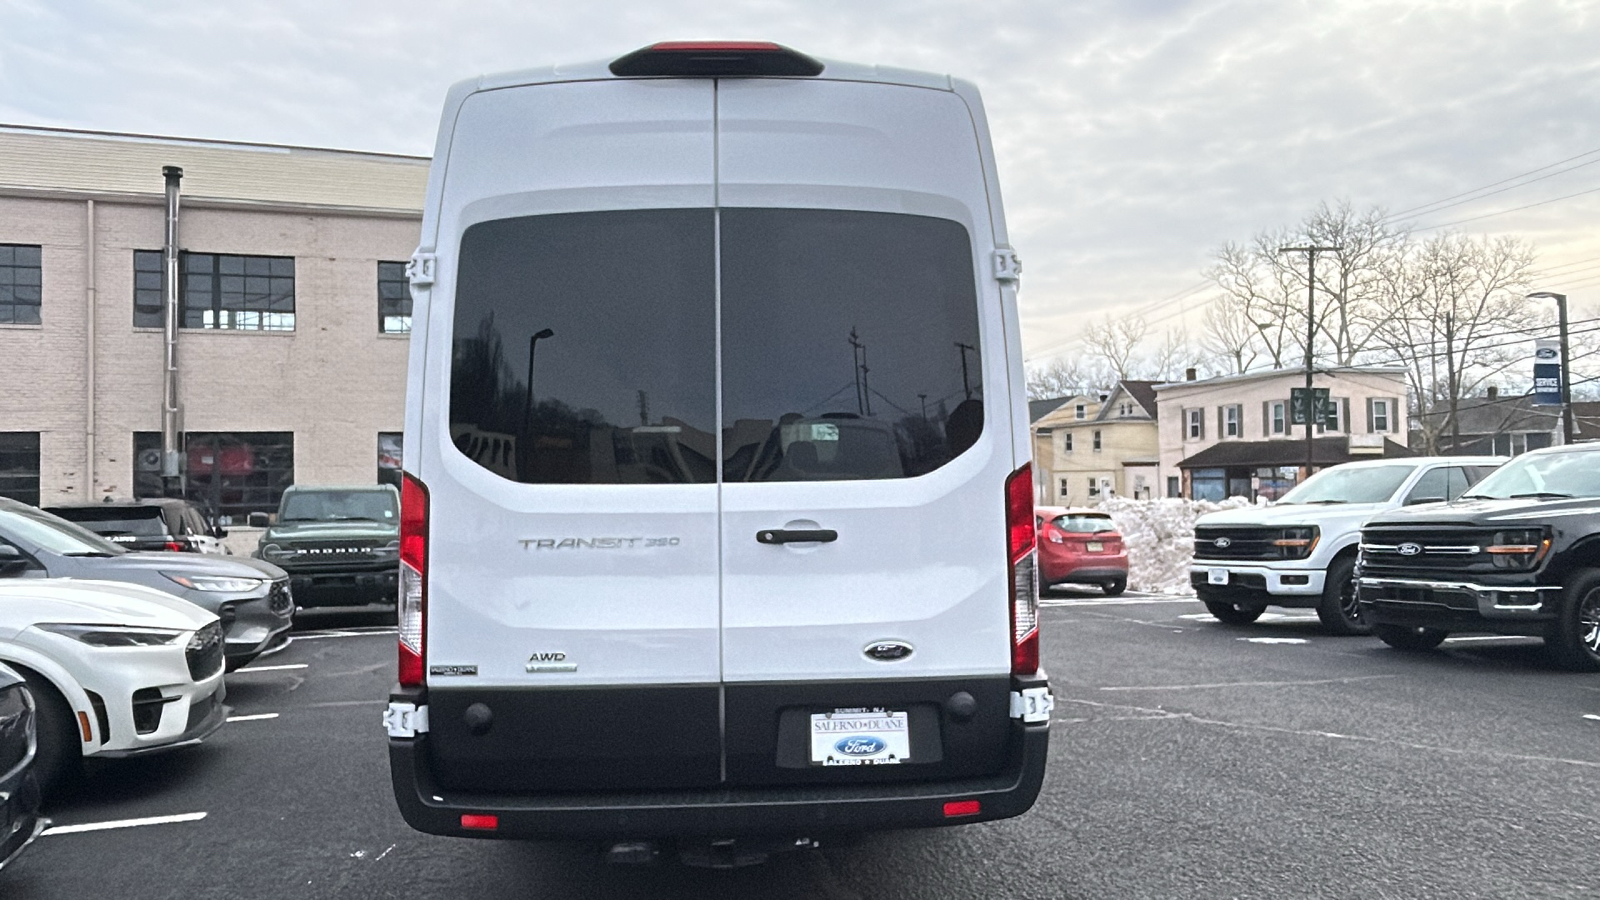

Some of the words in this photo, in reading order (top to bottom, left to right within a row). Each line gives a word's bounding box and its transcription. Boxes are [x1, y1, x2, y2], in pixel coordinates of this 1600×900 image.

[518, 537, 643, 550] TRANSIT
[529, 652, 566, 661] AWD
[814, 720, 862, 731] SALERNO
[868, 719, 904, 729] DUANE
[844, 739, 876, 753] Ford
